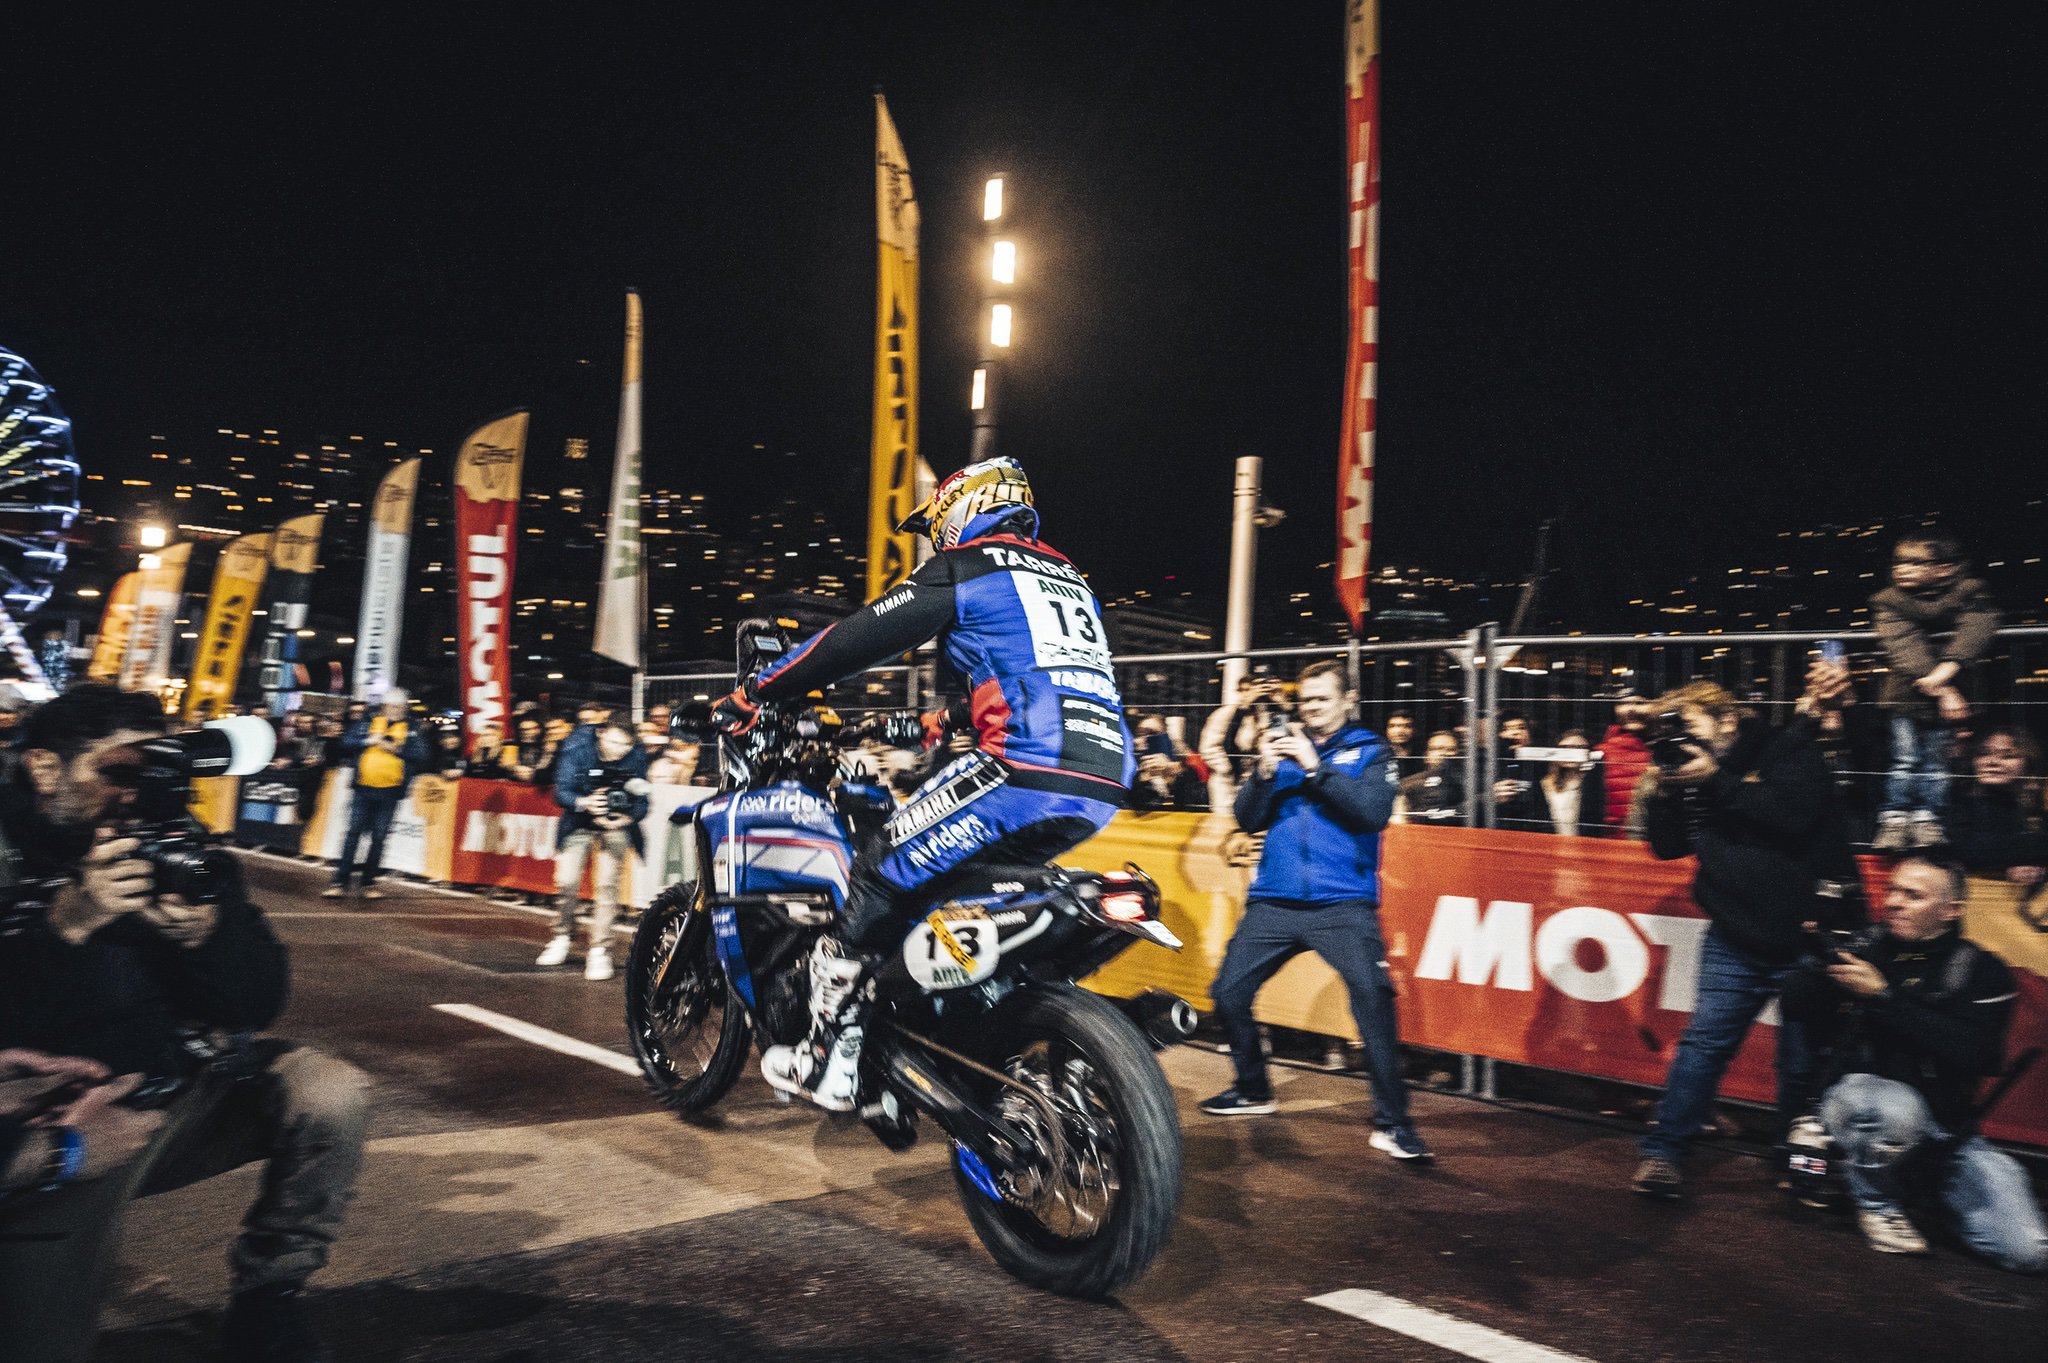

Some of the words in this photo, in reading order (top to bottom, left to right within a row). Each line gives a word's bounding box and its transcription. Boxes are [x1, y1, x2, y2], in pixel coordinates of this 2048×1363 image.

[872, 589, 915, 617] YAMAHA
[1048, 600, 1098, 643] 13
[468, 524, 509, 738] MOTUL
[461, 809, 561, 861] MOTU
[1414, 895, 1713, 1012] MOT
